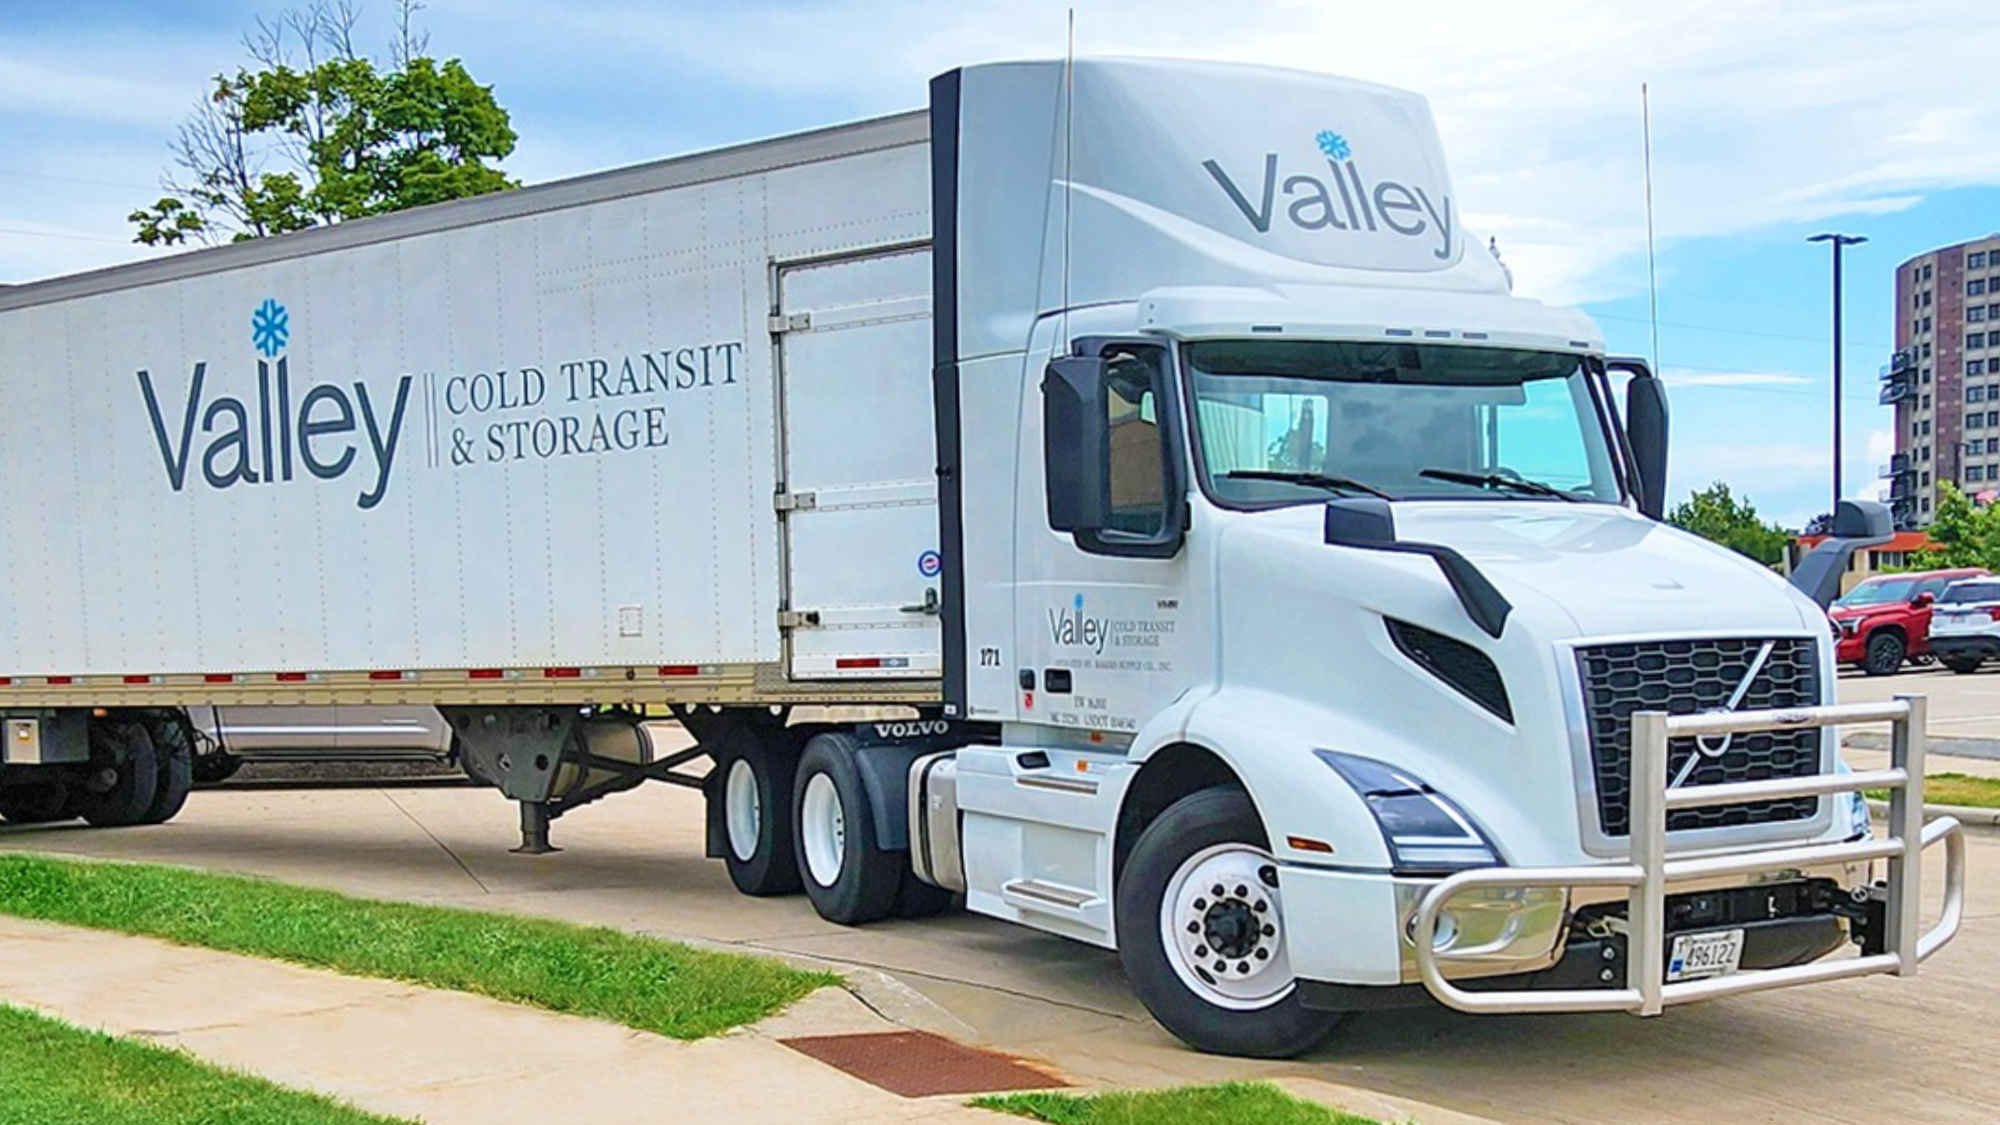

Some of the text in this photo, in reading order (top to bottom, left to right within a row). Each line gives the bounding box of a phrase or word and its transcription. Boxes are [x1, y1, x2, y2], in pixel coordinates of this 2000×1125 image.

[1202, 153, 1451, 259] Valley
[446, 342, 743, 416] COLD TRANSIT
[137, 355, 413, 509] Valley
[451, 407, 670, 466] & STORAGE
[1049, 607, 1109, 655] Valley
[1114, 621, 1175, 634] COLD TRANSIT
[1122, 635, 1159, 647] STORAGE
[980, 648, 1000, 666] 171
[874, 720, 948, 738] VOLVO
